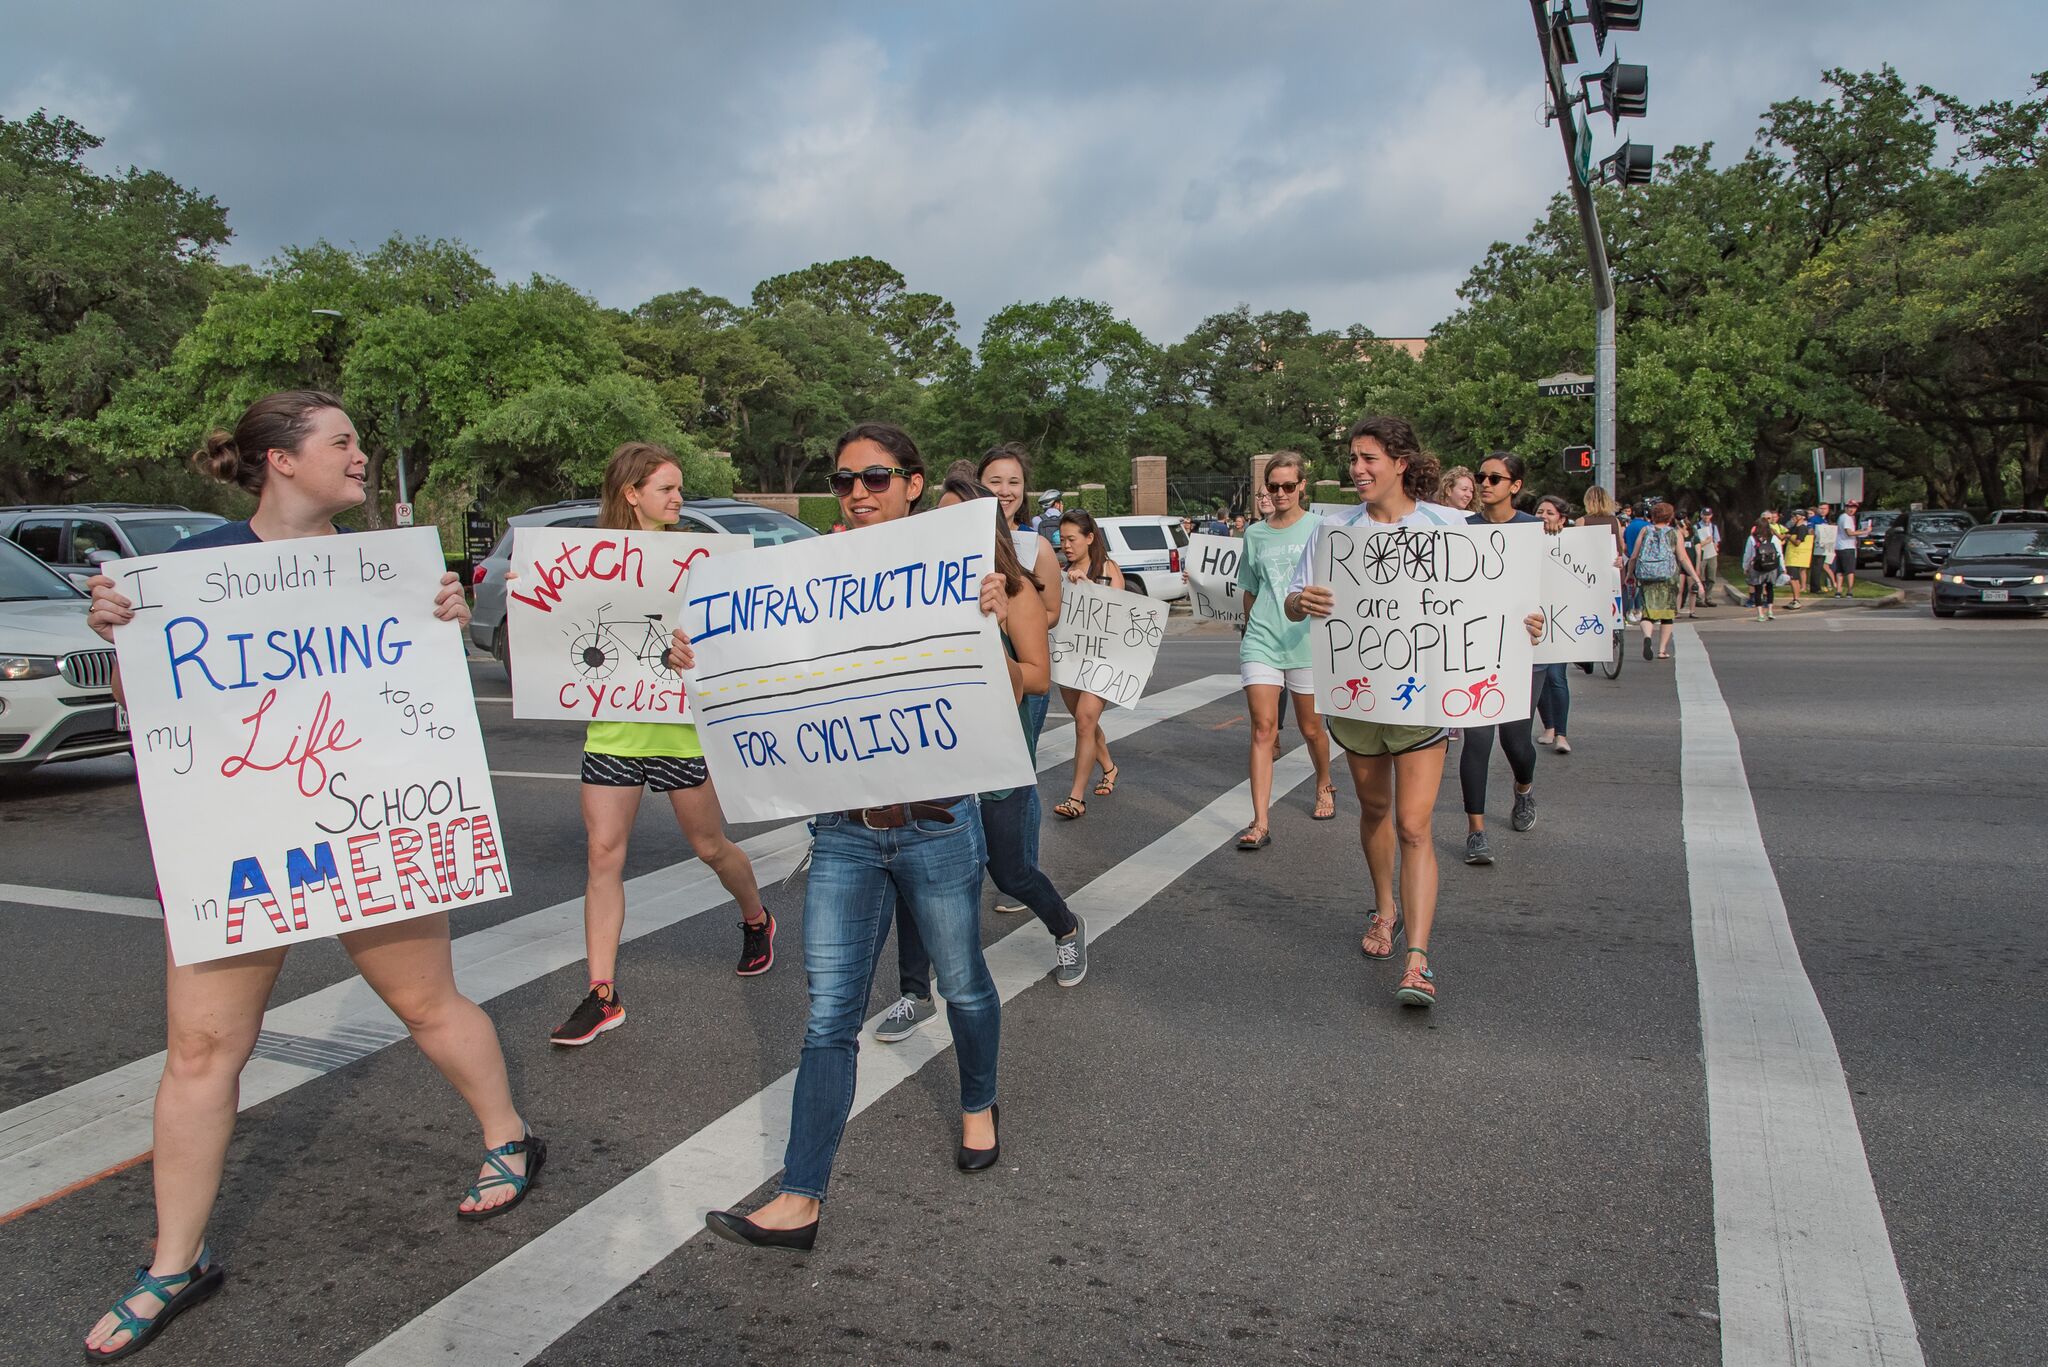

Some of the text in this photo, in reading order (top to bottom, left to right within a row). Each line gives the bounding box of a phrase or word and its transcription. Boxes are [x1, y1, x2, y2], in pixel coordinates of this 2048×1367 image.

[1548, 384, 1585, 395] MAIN
[123, 548, 399, 611] I shouldn't be
[511, 536, 644, 613] Watch
[1200, 545, 1242, 579] HO
[1550, 537, 1597, 585] down
[689, 554, 983, 645] INFRASTRUCTURE
[1061, 587, 1122, 635] HARE
[1225, 581, 1237, 597] IF
[1356, 588, 1464, 621] are for
[164, 616, 412, 699] RISKING
[1074, 633, 1109, 660] THE
[559, 679, 692, 718] cyclist
[1073, 658, 1140, 703] ROAD
[146, 682, 410, 797] my Life to
[399, 702, 435, 735] go
[425, 722, 456, 741] to
[732, 698, 958, 769] FOR CYCLISTS
[315, 772, 480, 834] SCHOOL
[191, 814, 509, 944] in AMERICA
